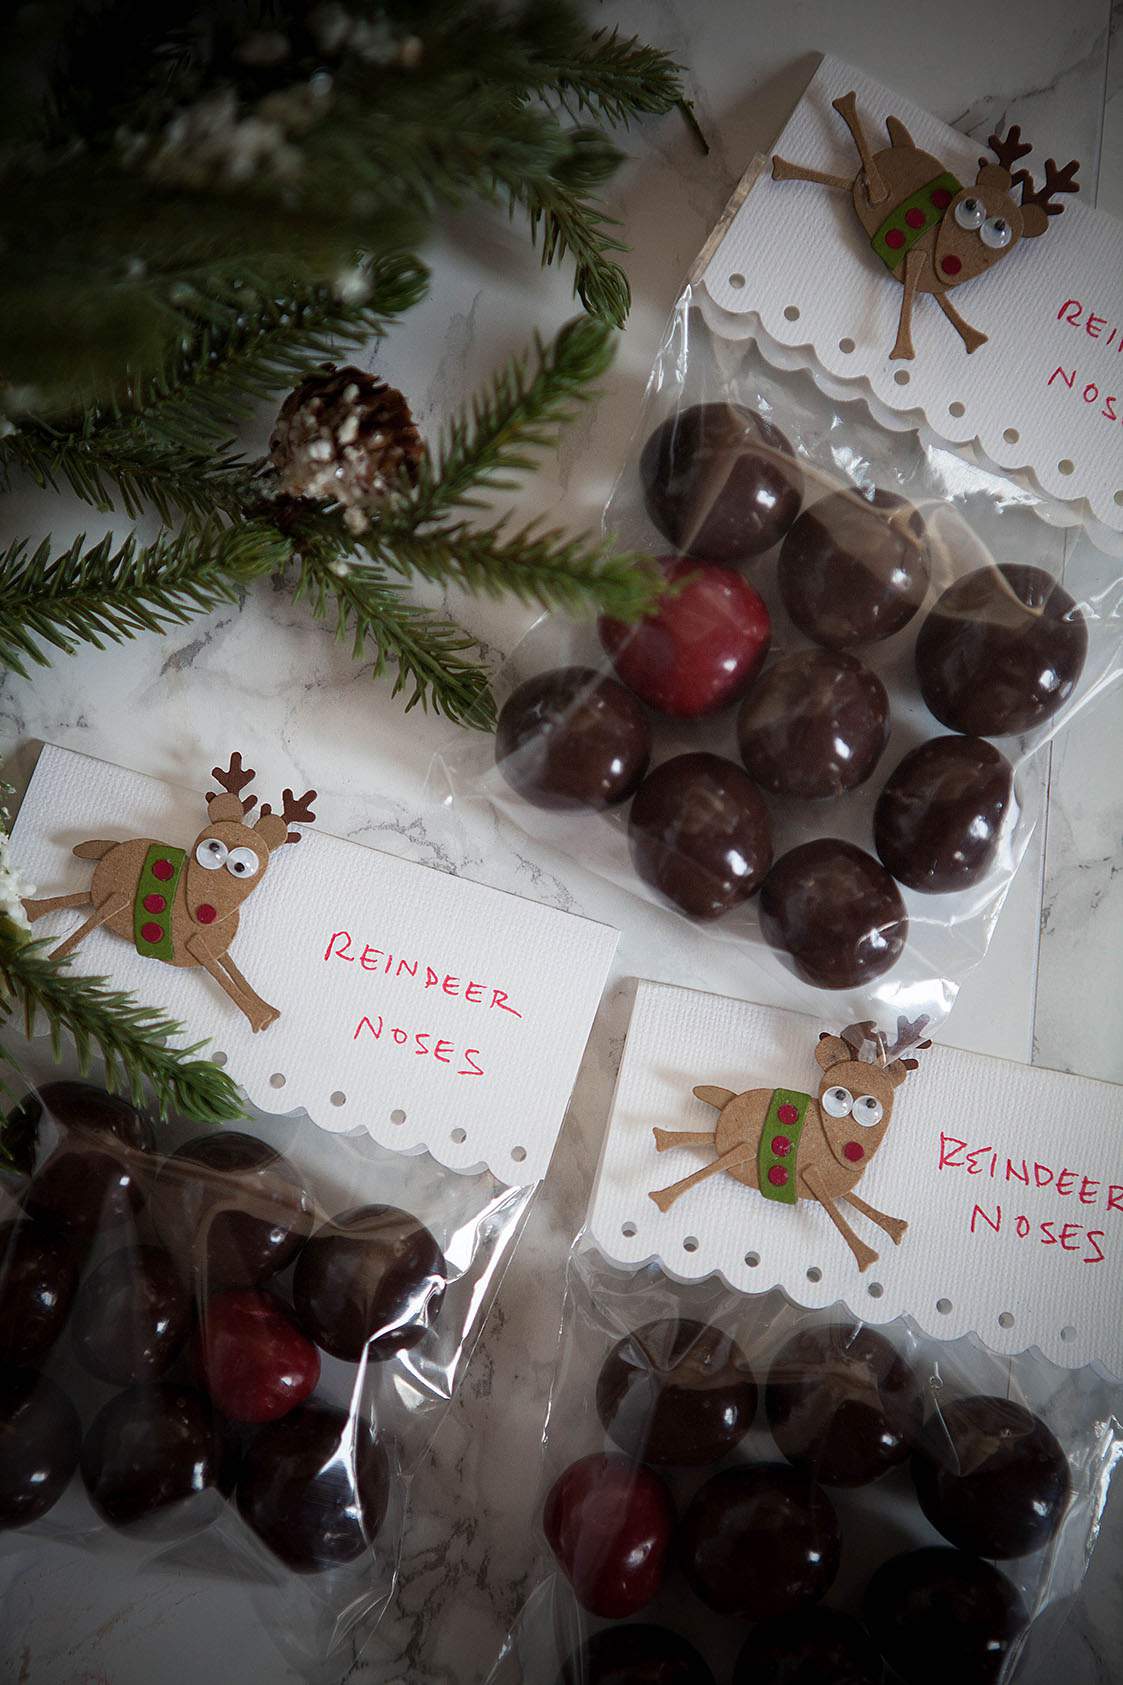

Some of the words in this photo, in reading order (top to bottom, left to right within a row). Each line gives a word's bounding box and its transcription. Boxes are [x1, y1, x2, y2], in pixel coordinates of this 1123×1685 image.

[1057, 299, 1123, 352] REI
[1047, 366, 1123, 425] NOS
[324, 931, 522, 1018] REINDEER
[354, 1016, 485, 1076] NOSES
[939, 1131, 1123, 1212] REINDEER
[971, 1204, 1105, 1263] NOSES
